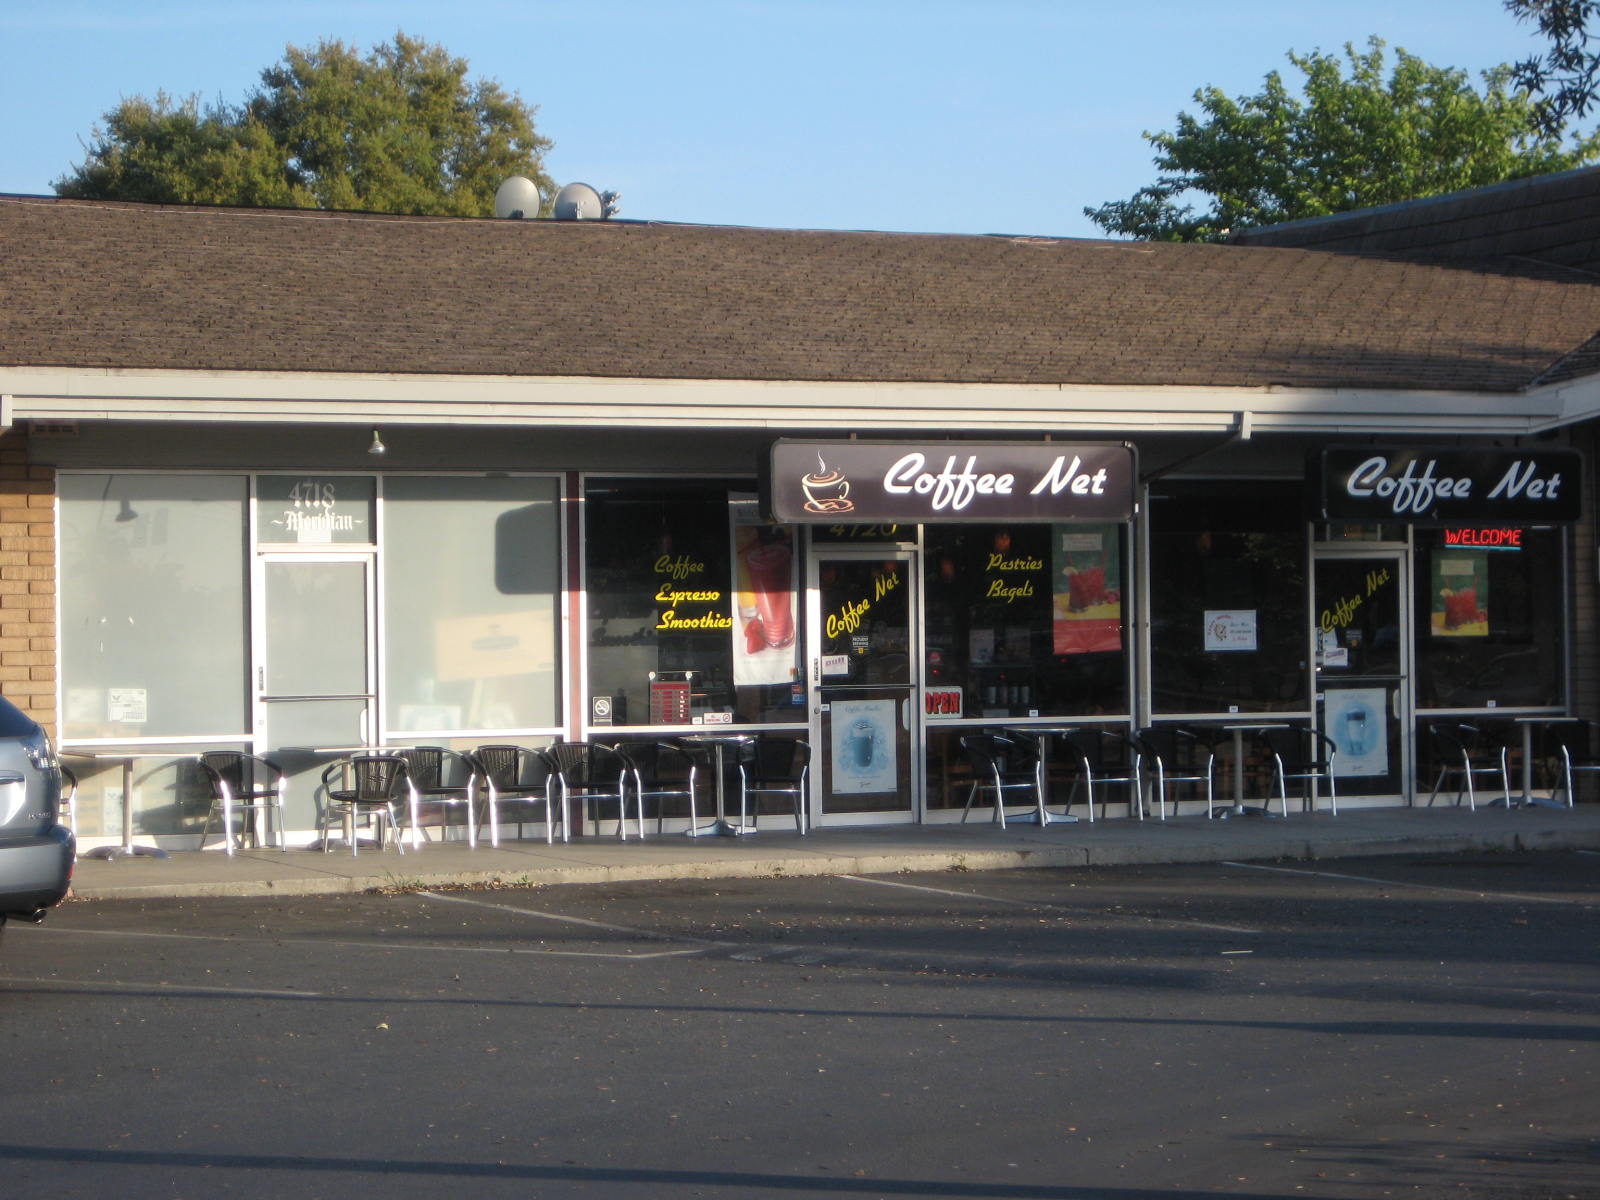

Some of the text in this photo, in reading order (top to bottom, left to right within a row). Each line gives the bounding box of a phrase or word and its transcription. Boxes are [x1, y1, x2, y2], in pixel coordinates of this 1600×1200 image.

[882, 452, 1108, 511] Coffee Net
[1346, 456, 1561, 513] Coffee Net
[288, 480, 336, 509] 4718
[1445, 528, 1523, 546] WELCOME
[654, 554, 705, 580] Coffee
[985, 553, 1043, 571] Pastries
[655, 583, 721, 607] Espresso
[986, 580, 1034, 603] Bagels
[1321, 567, 1390, 633] Coffee Net
[826, 571, 900, 639] Coffee Net
[655, 609, 734, 629] Smoothies
[925, 692, 961, 715] OPEN
